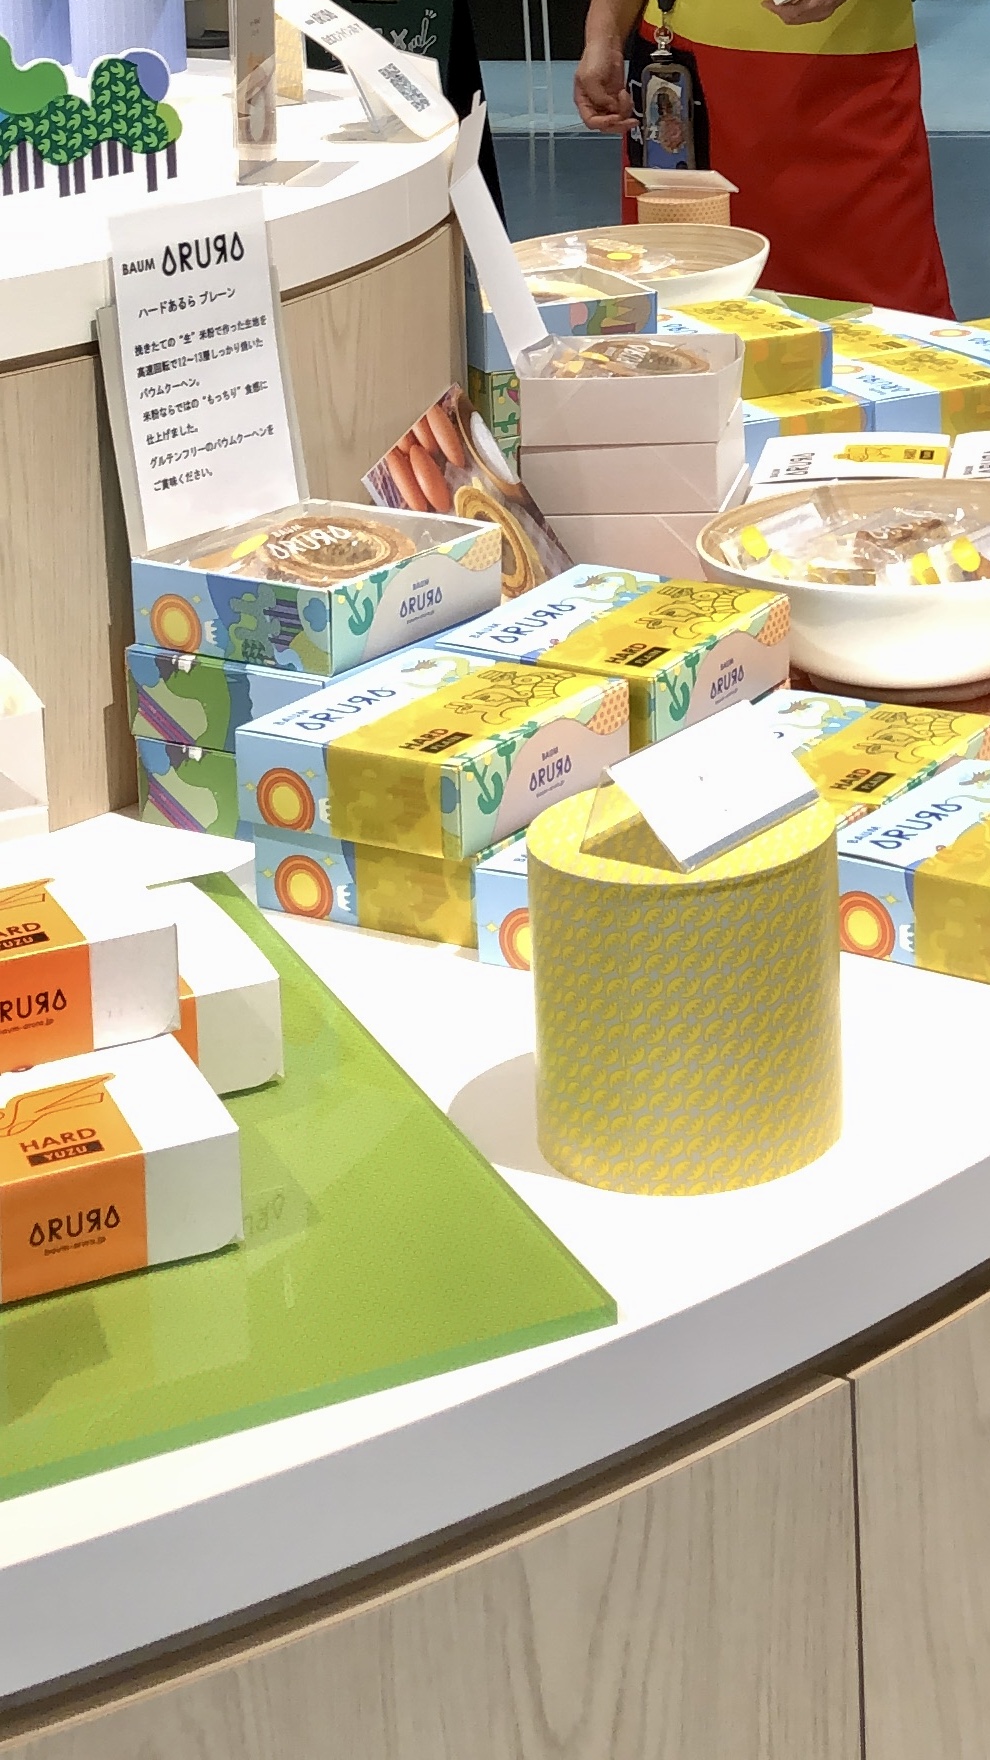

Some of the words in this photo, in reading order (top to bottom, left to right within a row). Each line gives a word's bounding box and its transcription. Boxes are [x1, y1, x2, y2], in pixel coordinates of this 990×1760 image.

[121, 257, 156, 276] BAUM
[604, 642, 648, 664] HARD
[398, 727, 450, 751] HARD
[829, 767, 871, 791] HARD
[19, 1127, 97, 1154] HARD
[43, 1144, 90, 1161] YUZU
